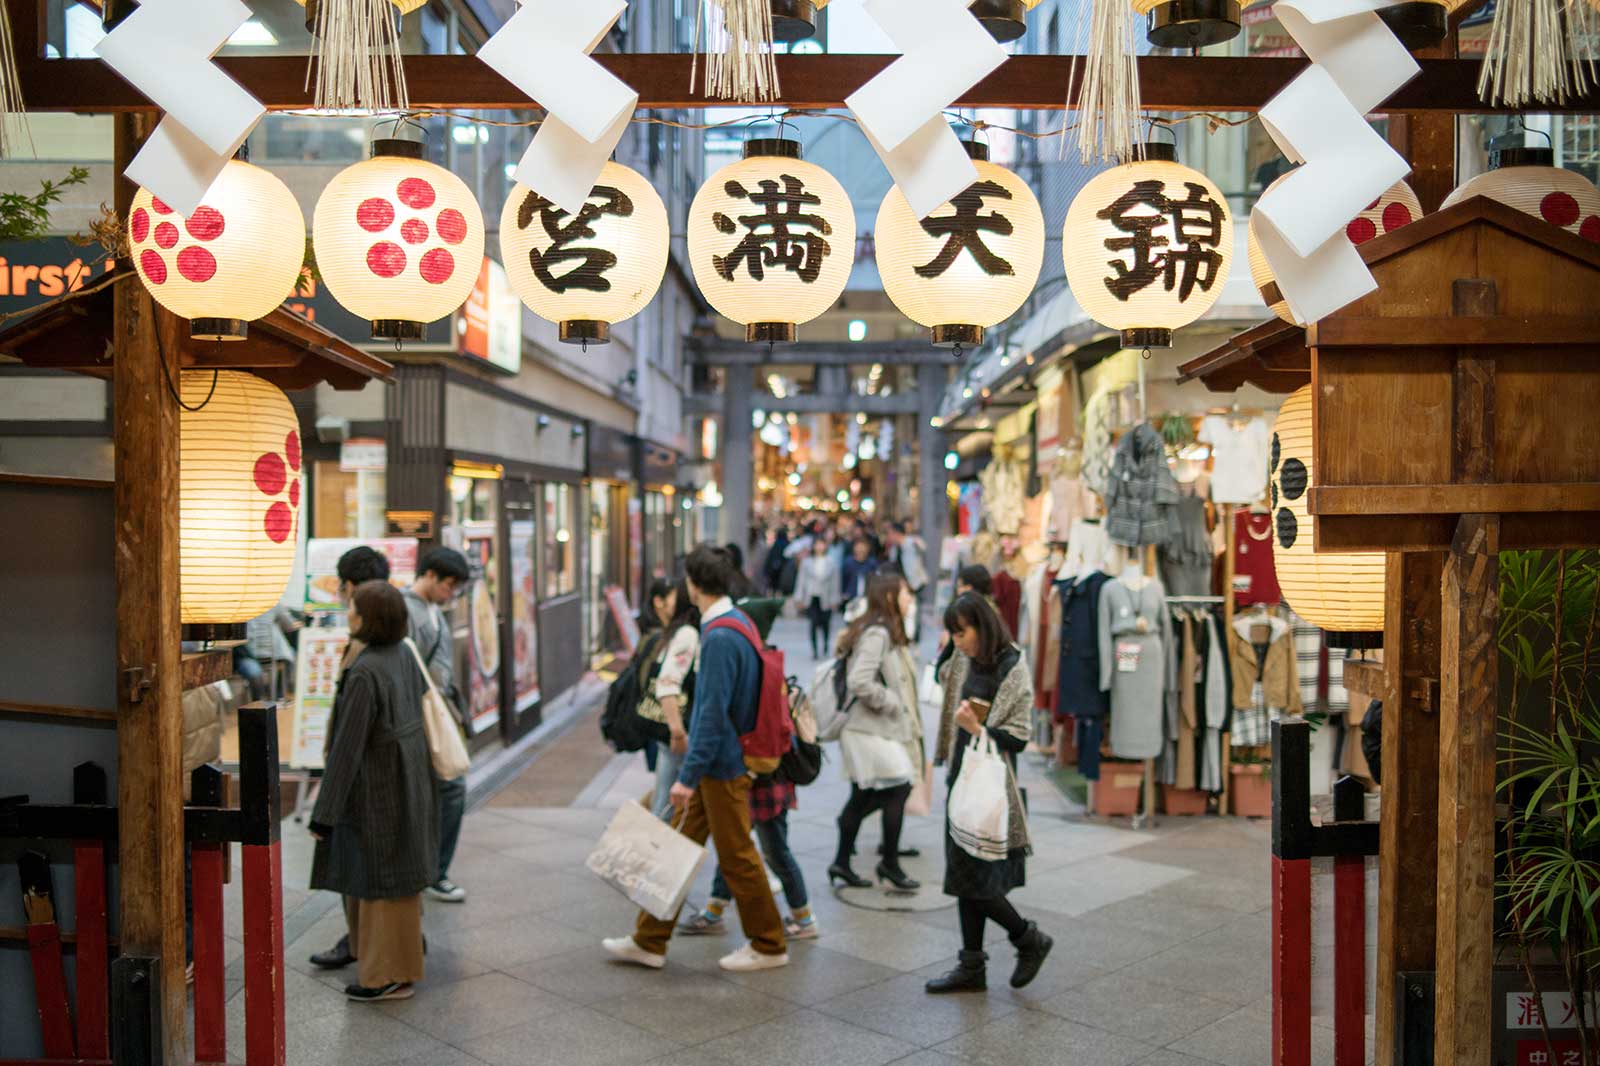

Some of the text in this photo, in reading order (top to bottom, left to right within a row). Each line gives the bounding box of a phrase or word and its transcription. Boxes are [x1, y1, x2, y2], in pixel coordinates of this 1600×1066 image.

[712, 174, 832, 283] 満
[912, 180, 1015, 279] 天
[1096, 180, 1226, 304] 錦
